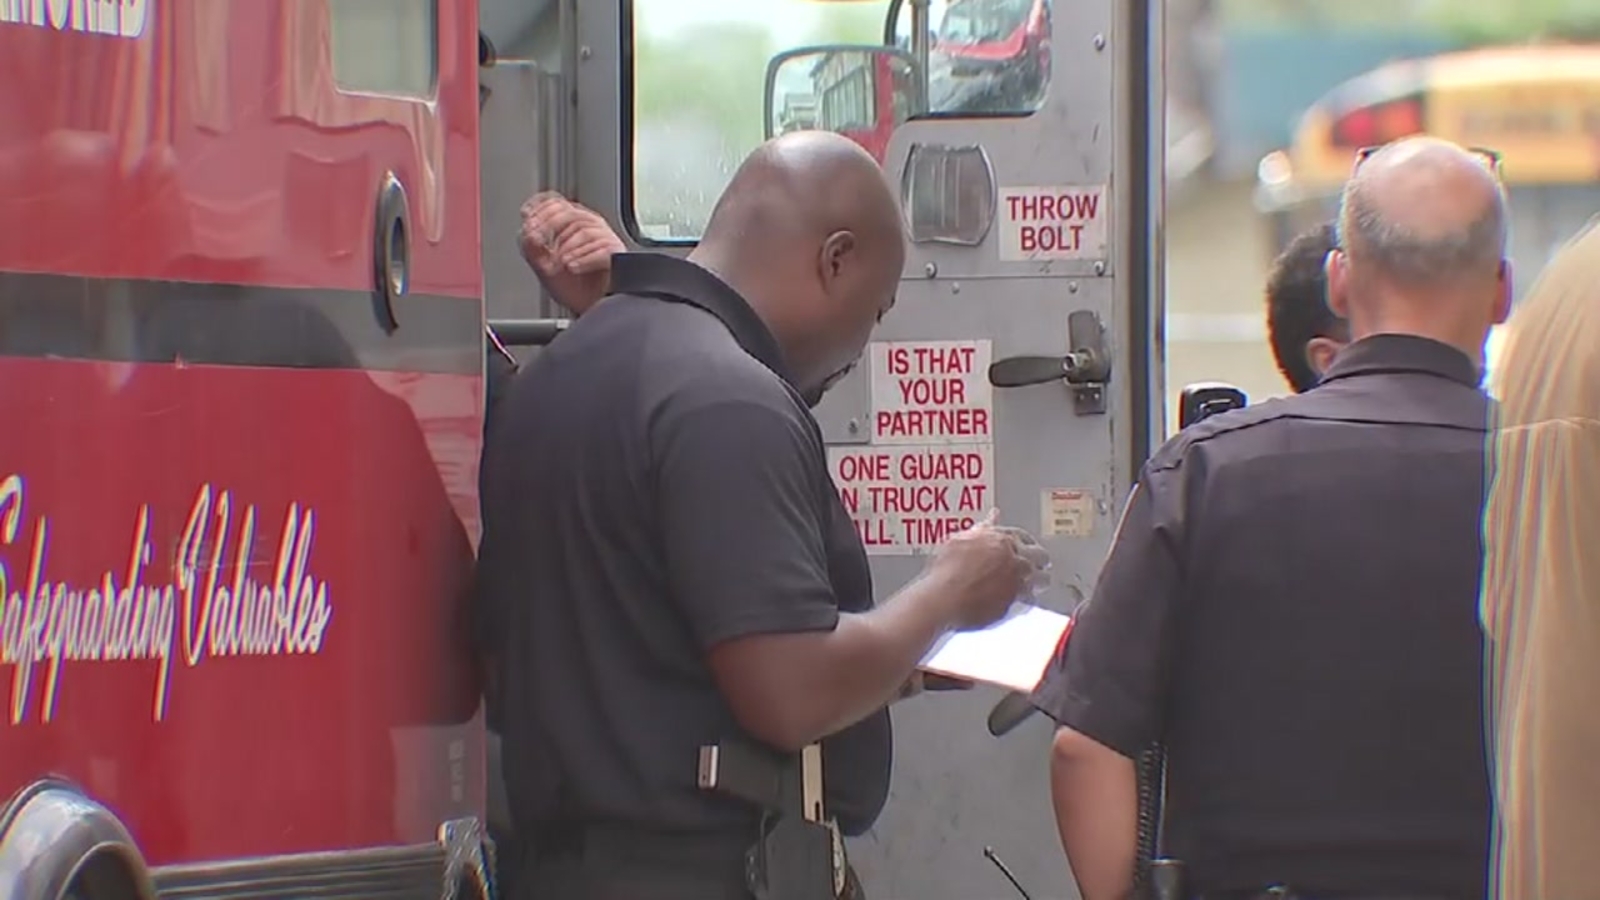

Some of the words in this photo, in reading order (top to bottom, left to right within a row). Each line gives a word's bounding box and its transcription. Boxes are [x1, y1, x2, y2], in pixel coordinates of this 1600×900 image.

[1006, 195, 1098, 220] THROW
[1021, 225, 1083, 251] BOLT
[888, 348, 910, 374] IS
[914, 348, 975, 374] THAT
[899, 379, 965, 404] YOUR
[877, 409, 988, 435] PARTNER
[839, 456, 890, 482] ONE
[900, 453, 983, 480] GUARD
[842, 488, 858, 514] N
[868, 486, 949, 513] TRUCK
[958, 485, 986, 511] AT
[178, 482, 332, 666] Valuables
